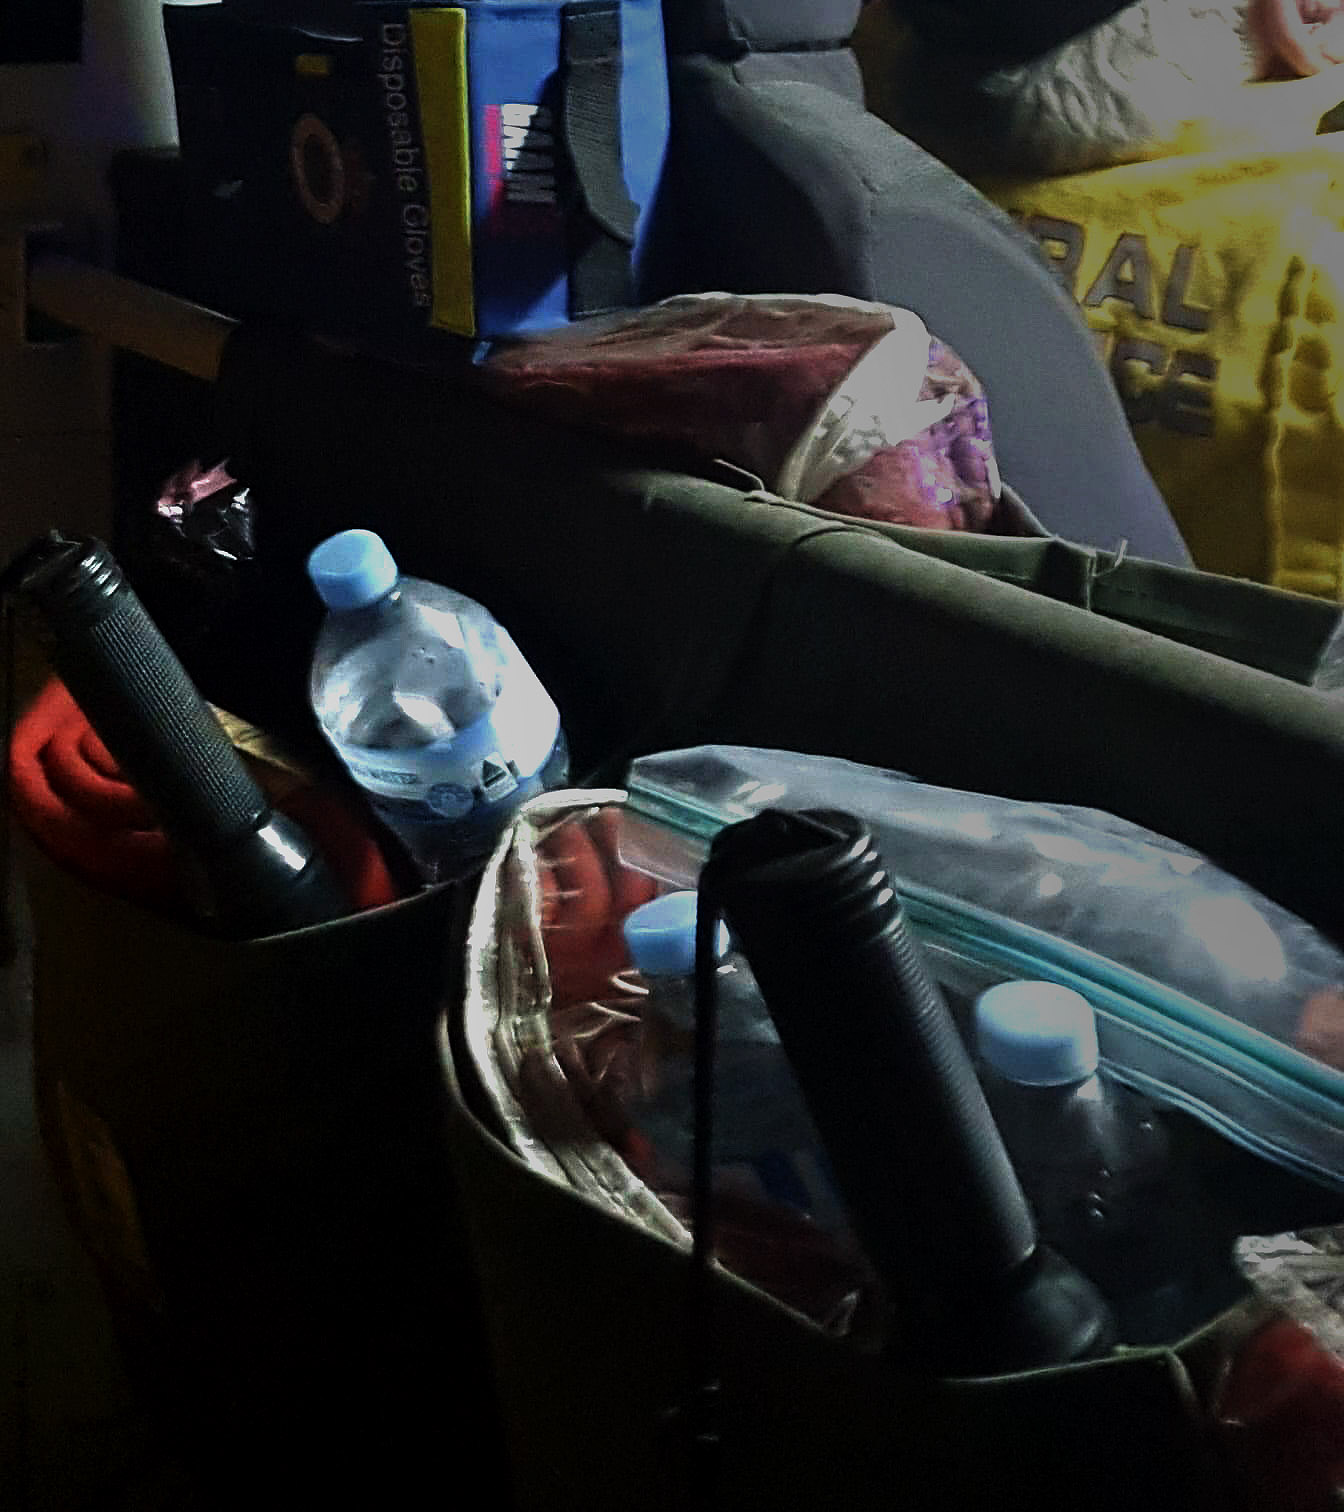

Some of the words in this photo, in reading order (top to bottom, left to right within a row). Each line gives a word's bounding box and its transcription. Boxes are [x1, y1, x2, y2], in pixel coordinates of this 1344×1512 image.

[376, 21, 422, 194] Disposable
[401, 202, 431, 308] Gloves
[1022, 212, 1213, 333] RAL
